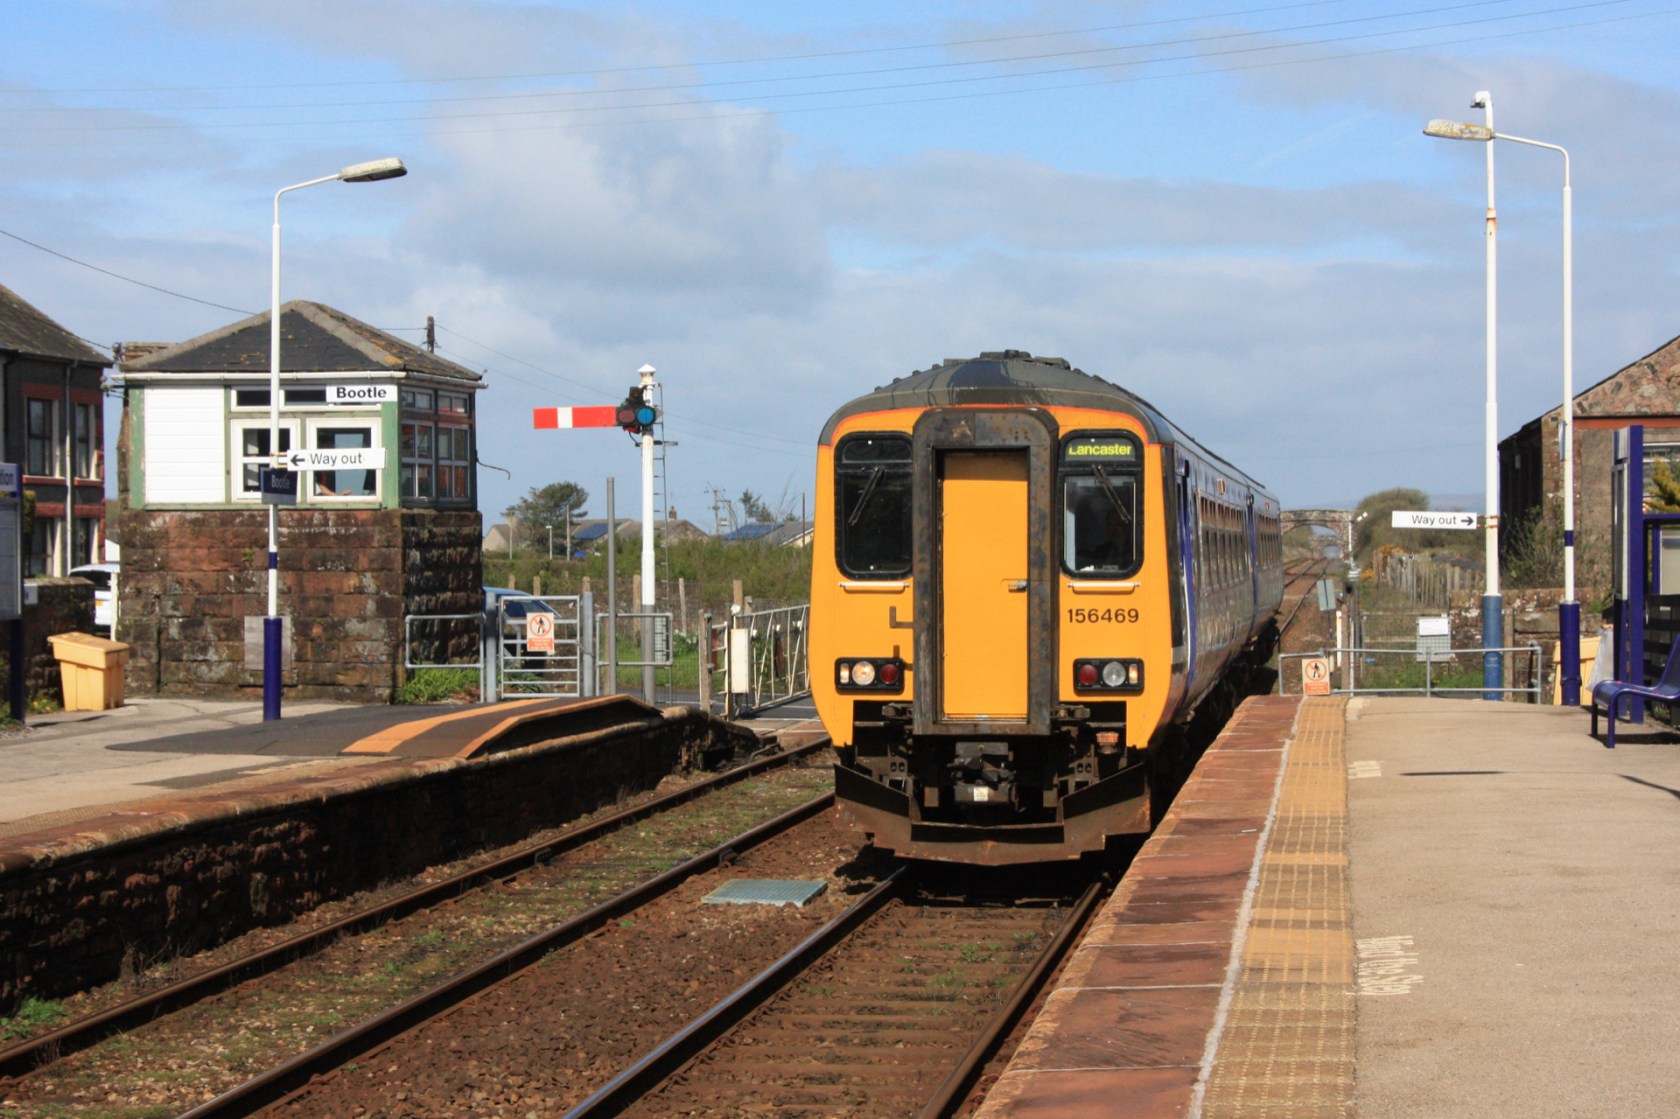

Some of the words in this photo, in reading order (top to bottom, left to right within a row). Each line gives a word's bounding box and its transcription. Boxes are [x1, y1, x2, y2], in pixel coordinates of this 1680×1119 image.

[336, 386, 387, 399] Bootle
[1068, 443, 1132, 456] Lancaster
[310, 453, 337, 467] Way
[341, 452, 363, 465] out
[1411, 514, 1436, 526] Way
[1438, 515, 1457, 525] out
[1067, 608, 1139, 624] 156469
